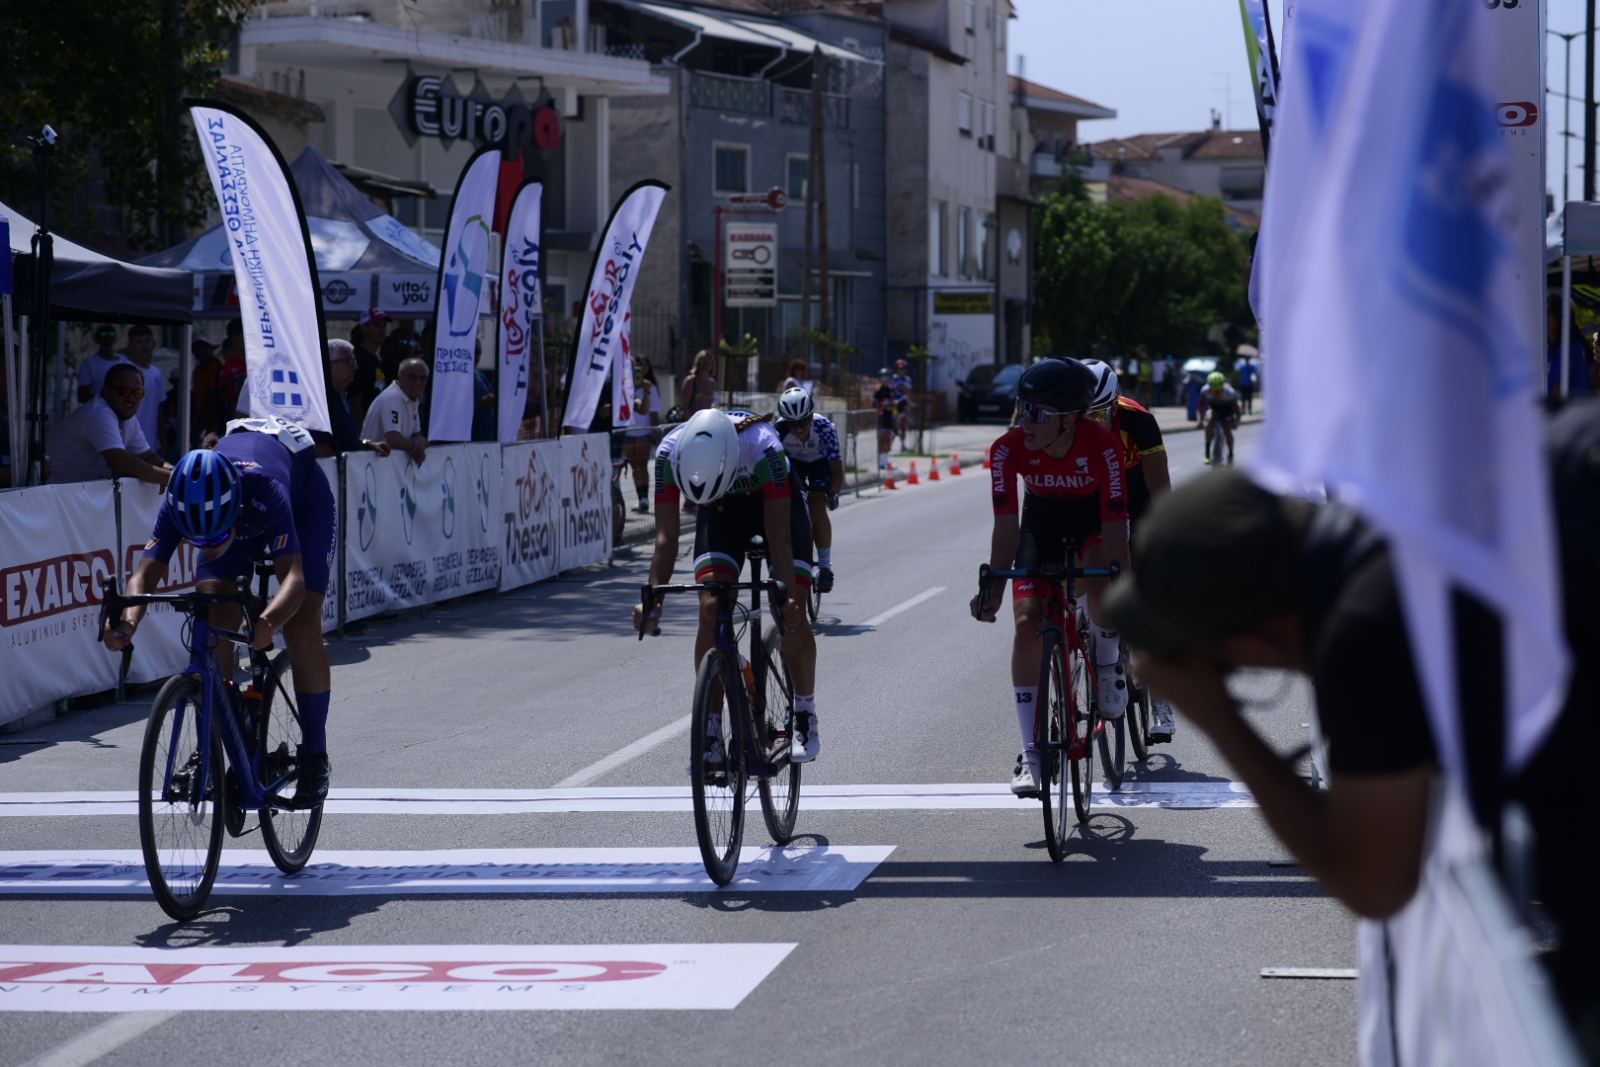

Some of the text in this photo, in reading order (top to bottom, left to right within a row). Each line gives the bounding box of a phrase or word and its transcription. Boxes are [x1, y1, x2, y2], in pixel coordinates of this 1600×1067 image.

[402, 293, 429, 306] you
[586, 232, 643, 376] Thessaly
[391, 410, 399, 424] 3
[993, 445, 1010, 493] ALBANIA
[1024, 474, 1096, 488] ALBANIA
[1102, 447, 1122, 499] ALBANIA
[504, 504, 559, 571] Thessaly
[562, 494, 610, 554] Thessaly
[1016, 692, 1033, 704] 13
[229, 983, 592, 993] SYSTEMS
